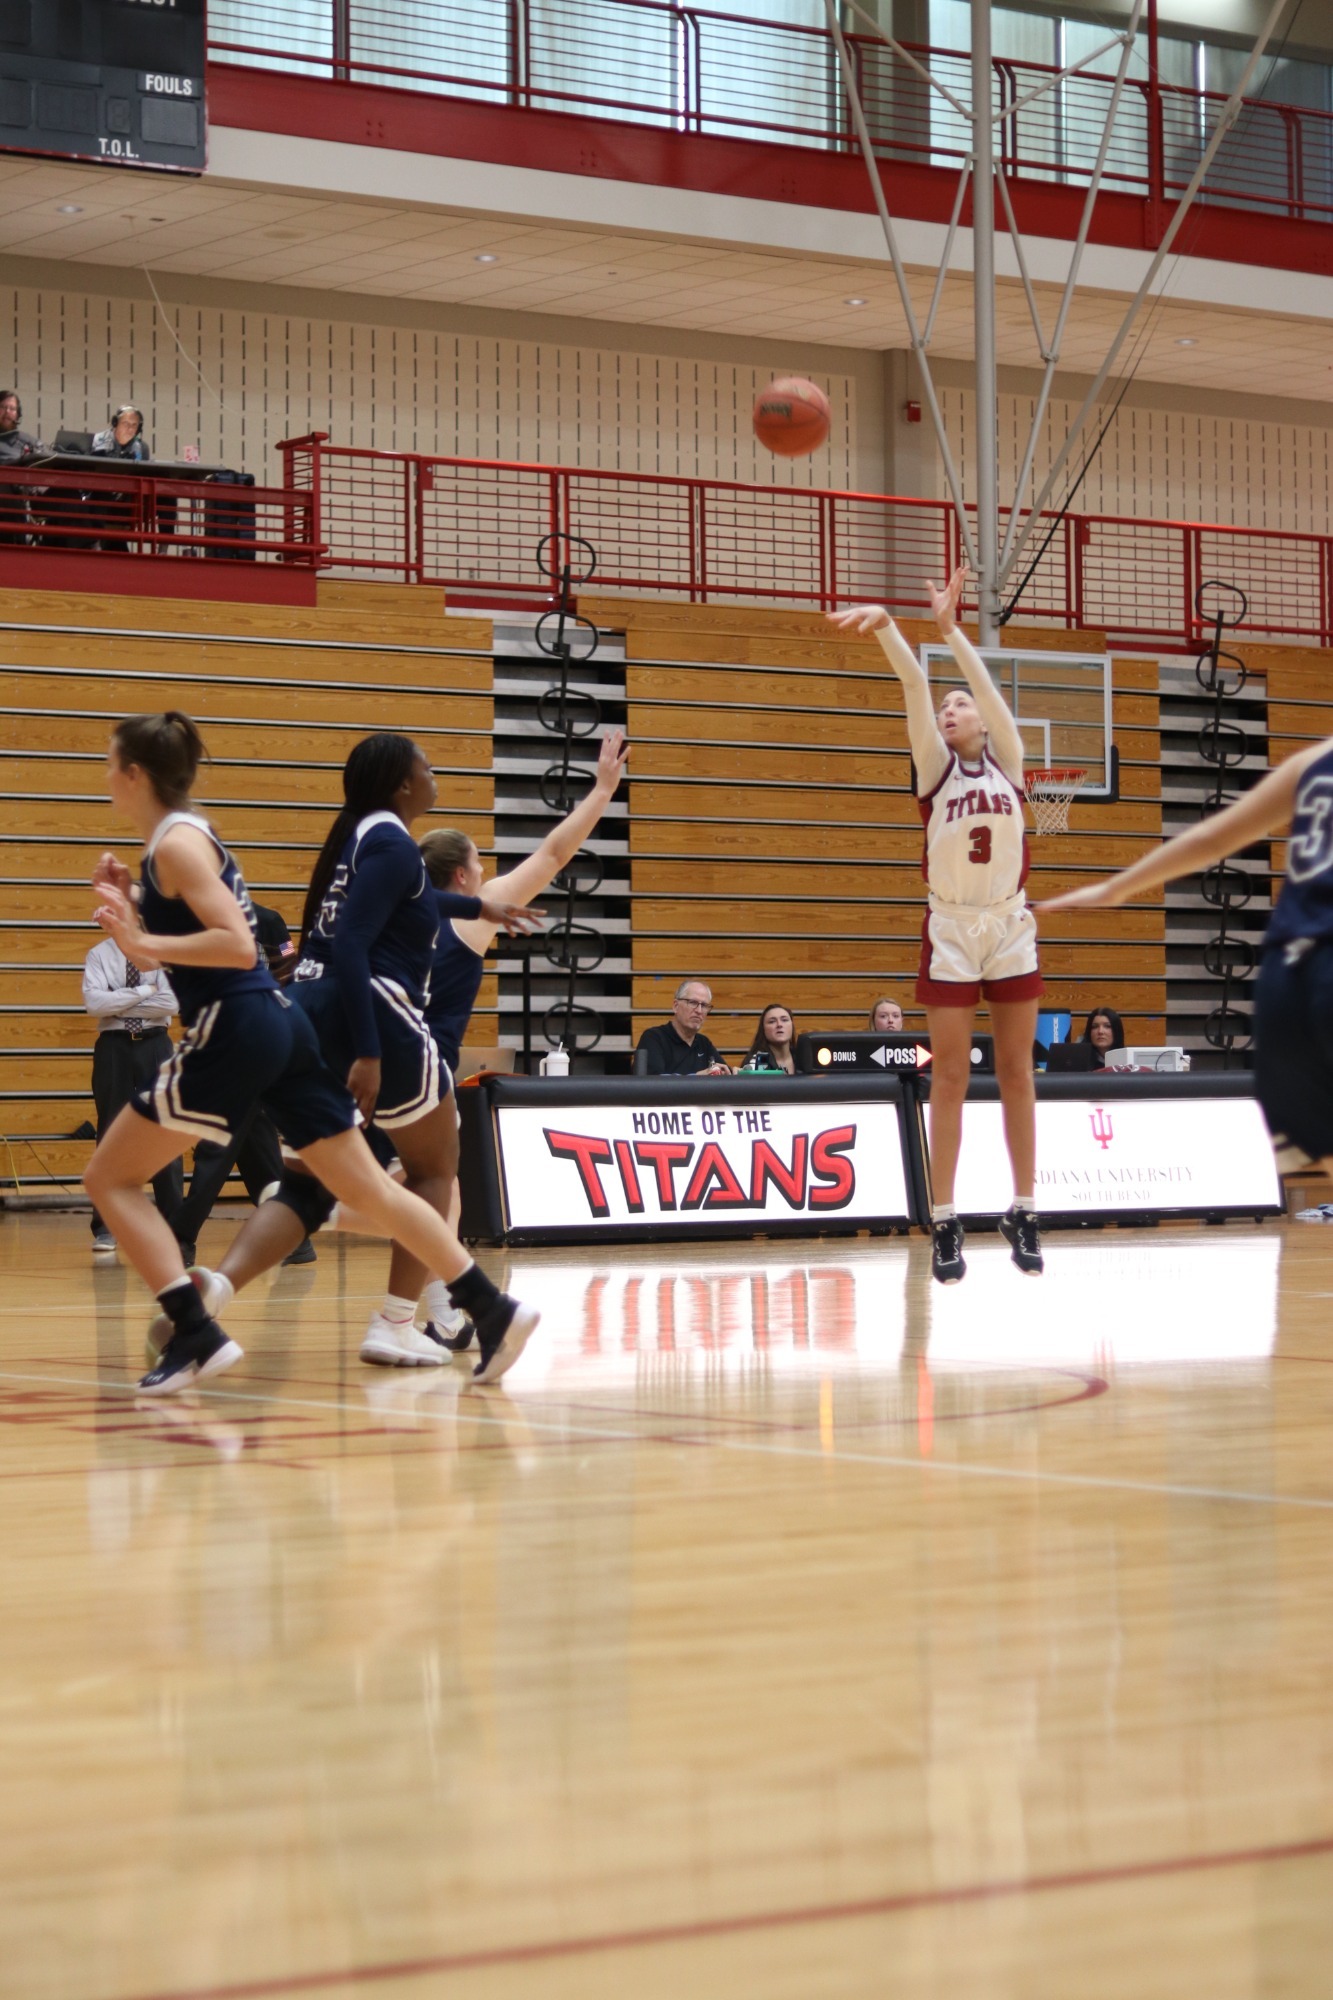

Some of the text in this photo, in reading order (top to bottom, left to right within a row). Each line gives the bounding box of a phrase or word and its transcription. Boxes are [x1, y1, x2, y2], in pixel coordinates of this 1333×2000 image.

[145, 73, 193, 96] FOULS
[98, 137, 140, 159] T.O.L.
[946, 788, 1013, 823] TITANS
[968, 825, 992, 864] 3
[832, 1051, 857, 1062] BONUS
[885, 1047, 917, 1065] POSS
[632, 1109, 773, 1135] HOME OF THE
[542, 1123, 858, 1219] TITANS
[1096, 1165, 1194, 1184] UNIVERSITY
